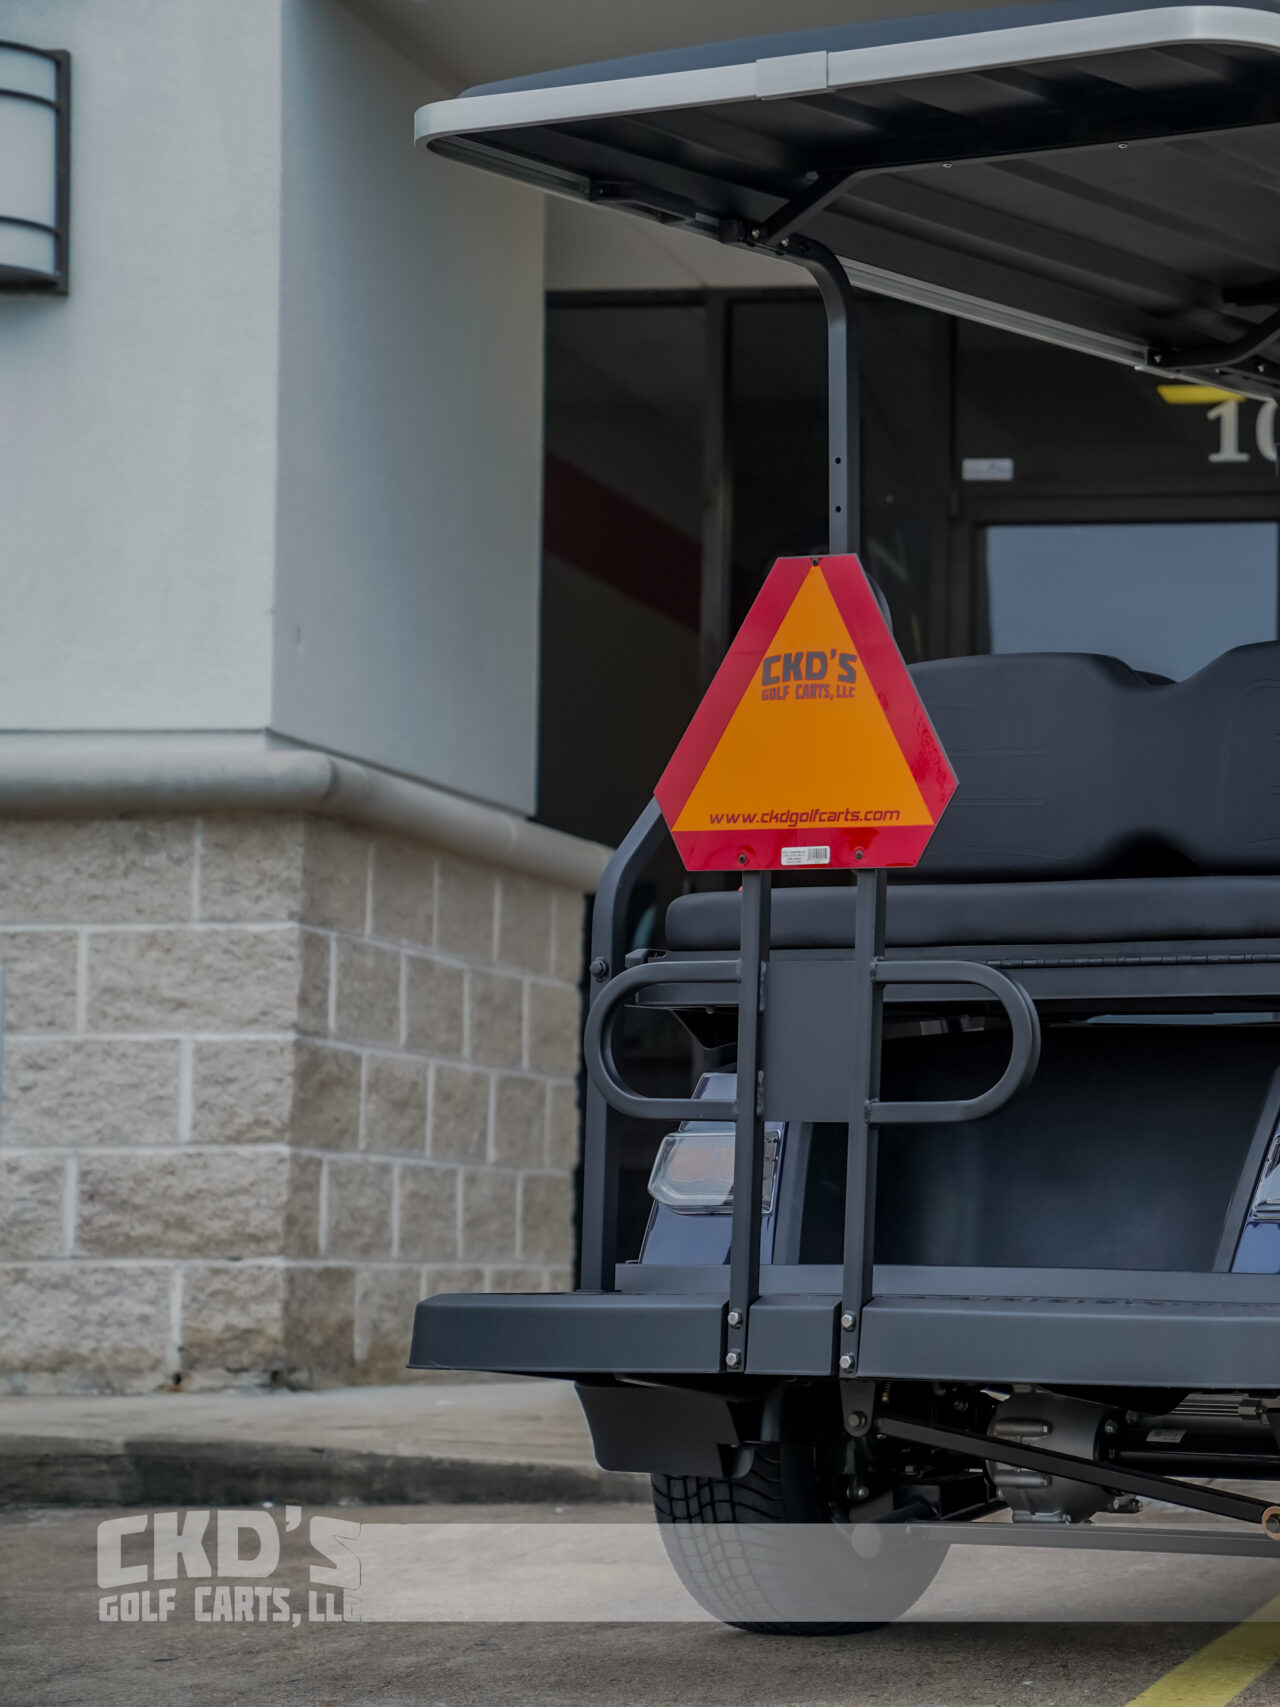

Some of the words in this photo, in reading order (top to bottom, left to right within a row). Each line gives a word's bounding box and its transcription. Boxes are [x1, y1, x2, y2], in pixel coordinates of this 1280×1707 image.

[762, 648, 857, 686] CKD'S
[761, 685, 790, 701] GOLF
[709, 808, 900, 828] www.ckdgolfcarts.com
